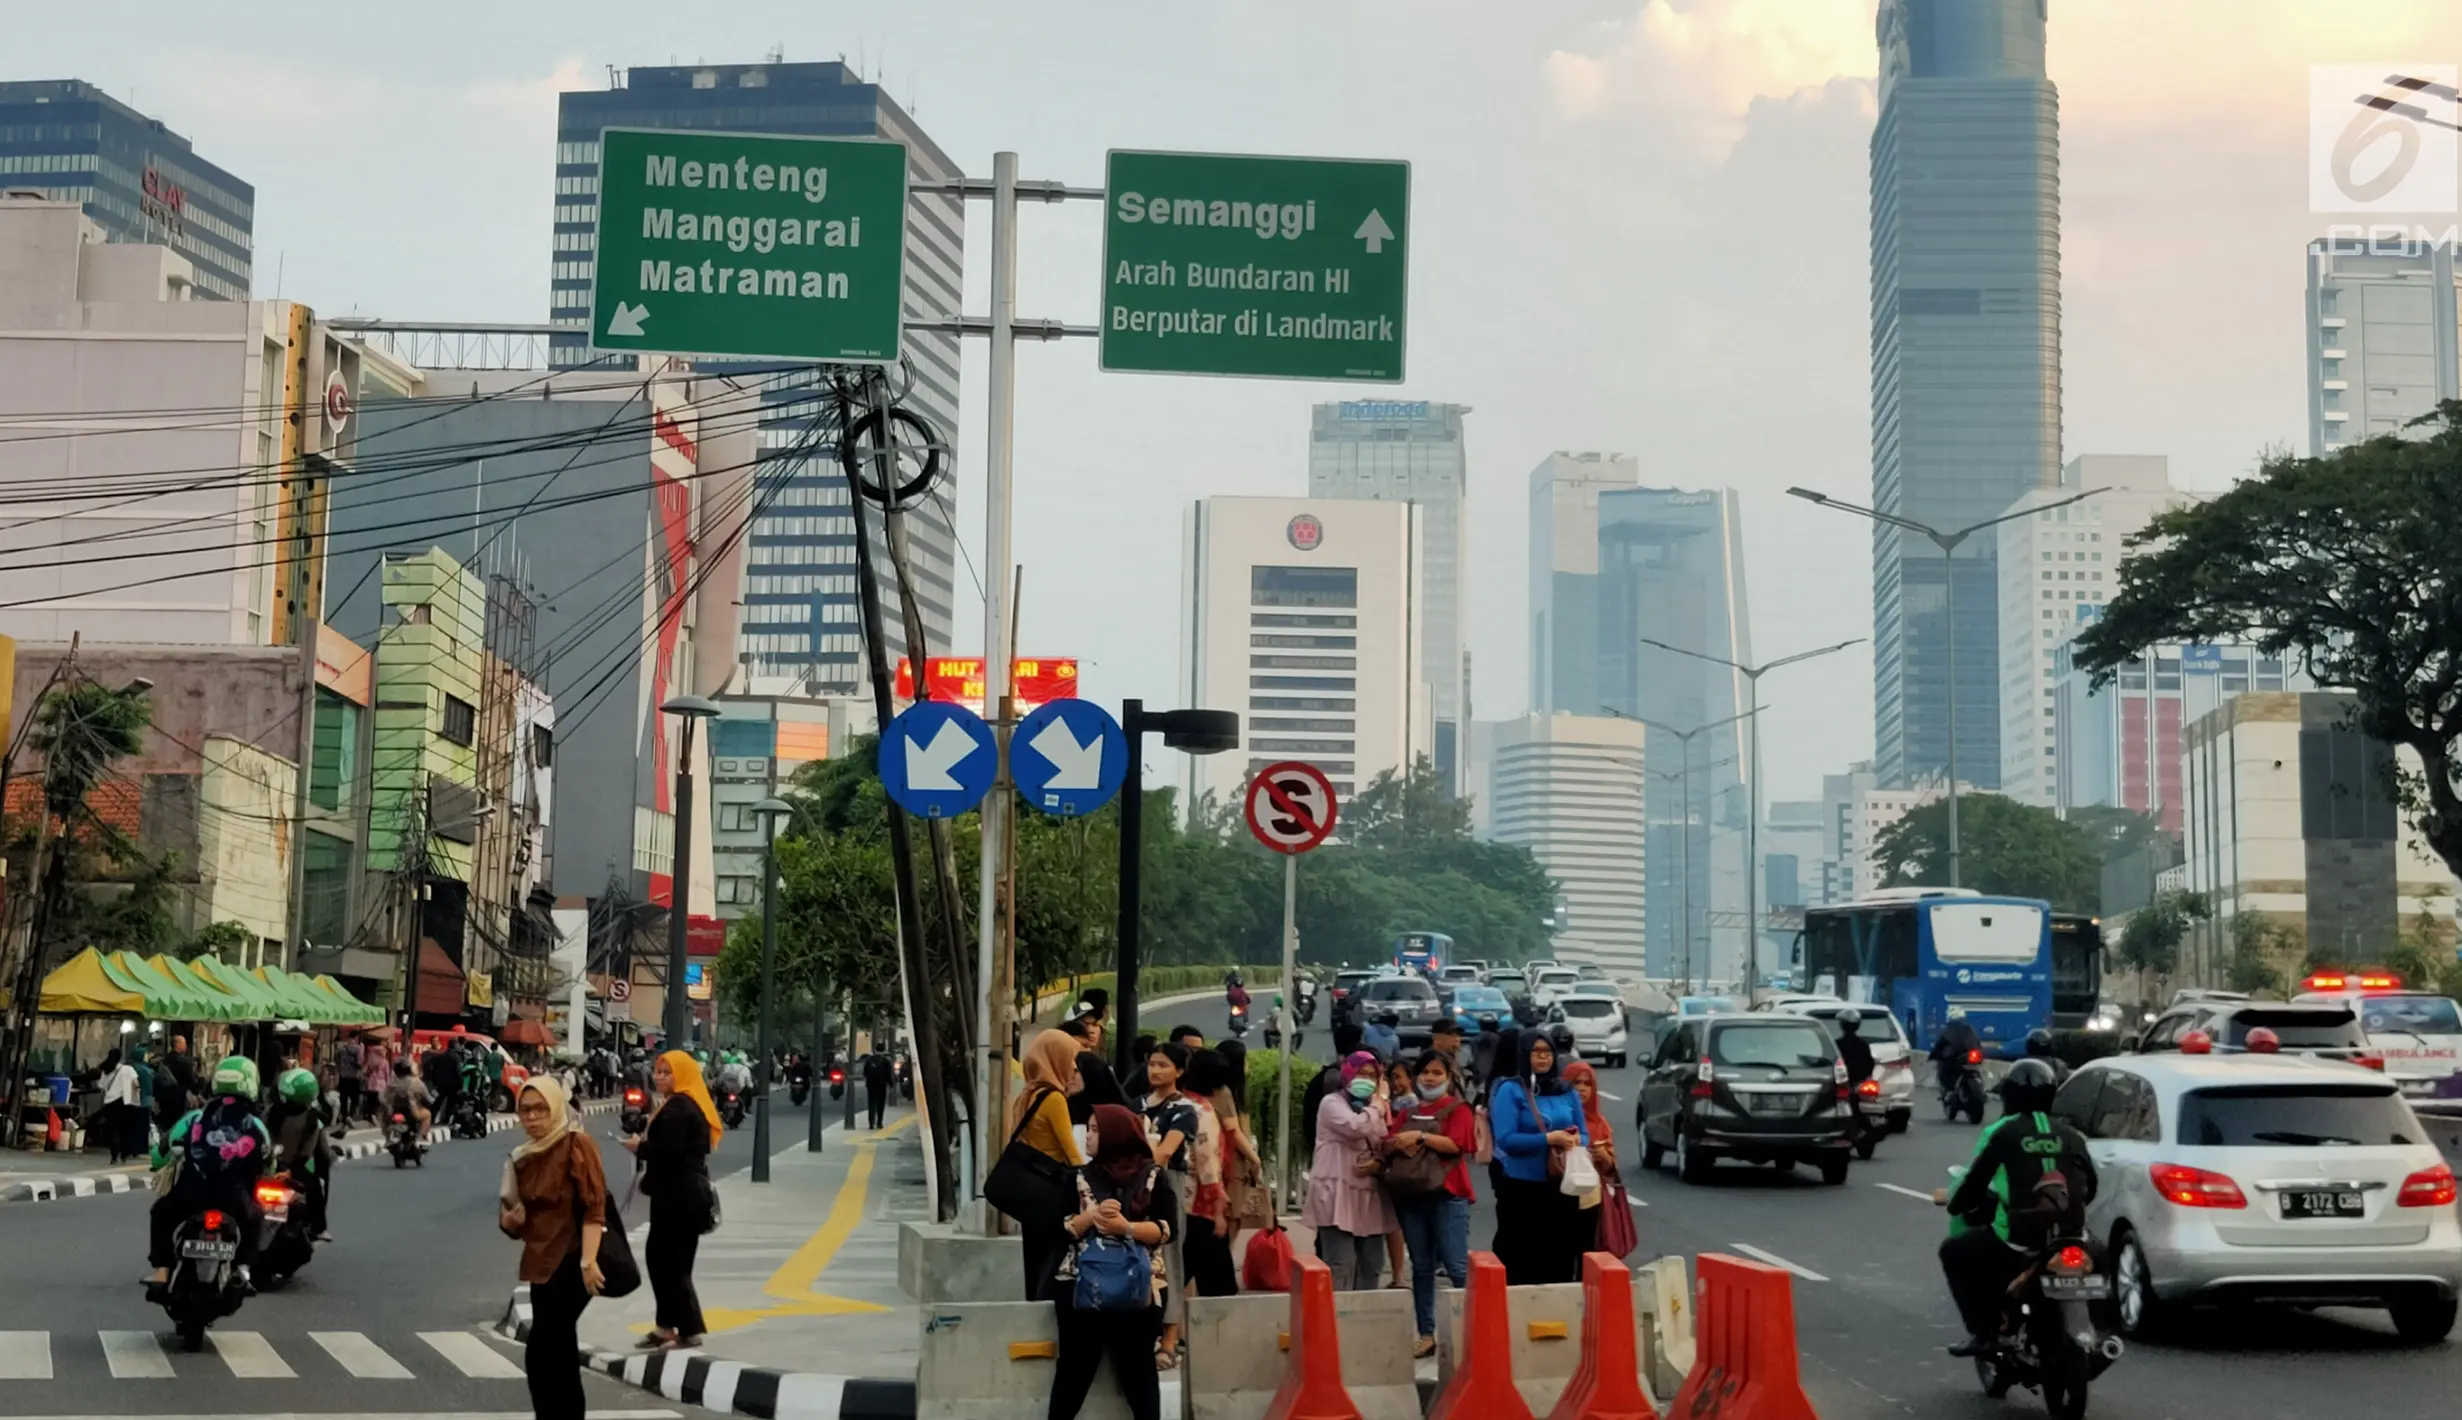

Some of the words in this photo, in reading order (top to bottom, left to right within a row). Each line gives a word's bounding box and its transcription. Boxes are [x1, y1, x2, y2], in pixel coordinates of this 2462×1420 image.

[646, 155, 828, 203] Menteng
[642, 207, 861, 254] Manggarai
[1117, 192, 1316, 240] Semanggi
[640, 259, 849, 299] Matraman
[1115, 260, 1176, 287] Arah
[1187, 262, 1315, 293] Bundaran
[1325, 268, 1350, 293] HI
[1112, 305, 1227, 338] Berputar
[1234, 309, 1258, 336] di
[1266, 312, 1394, 342] Landmark
[939, 662, 977, 678] HUT
[2020, 1135, 2063, 1154] Grab
[2281, 1193, 2291, 1210] B
[2302, 1191, 2334, 1210] 2172
